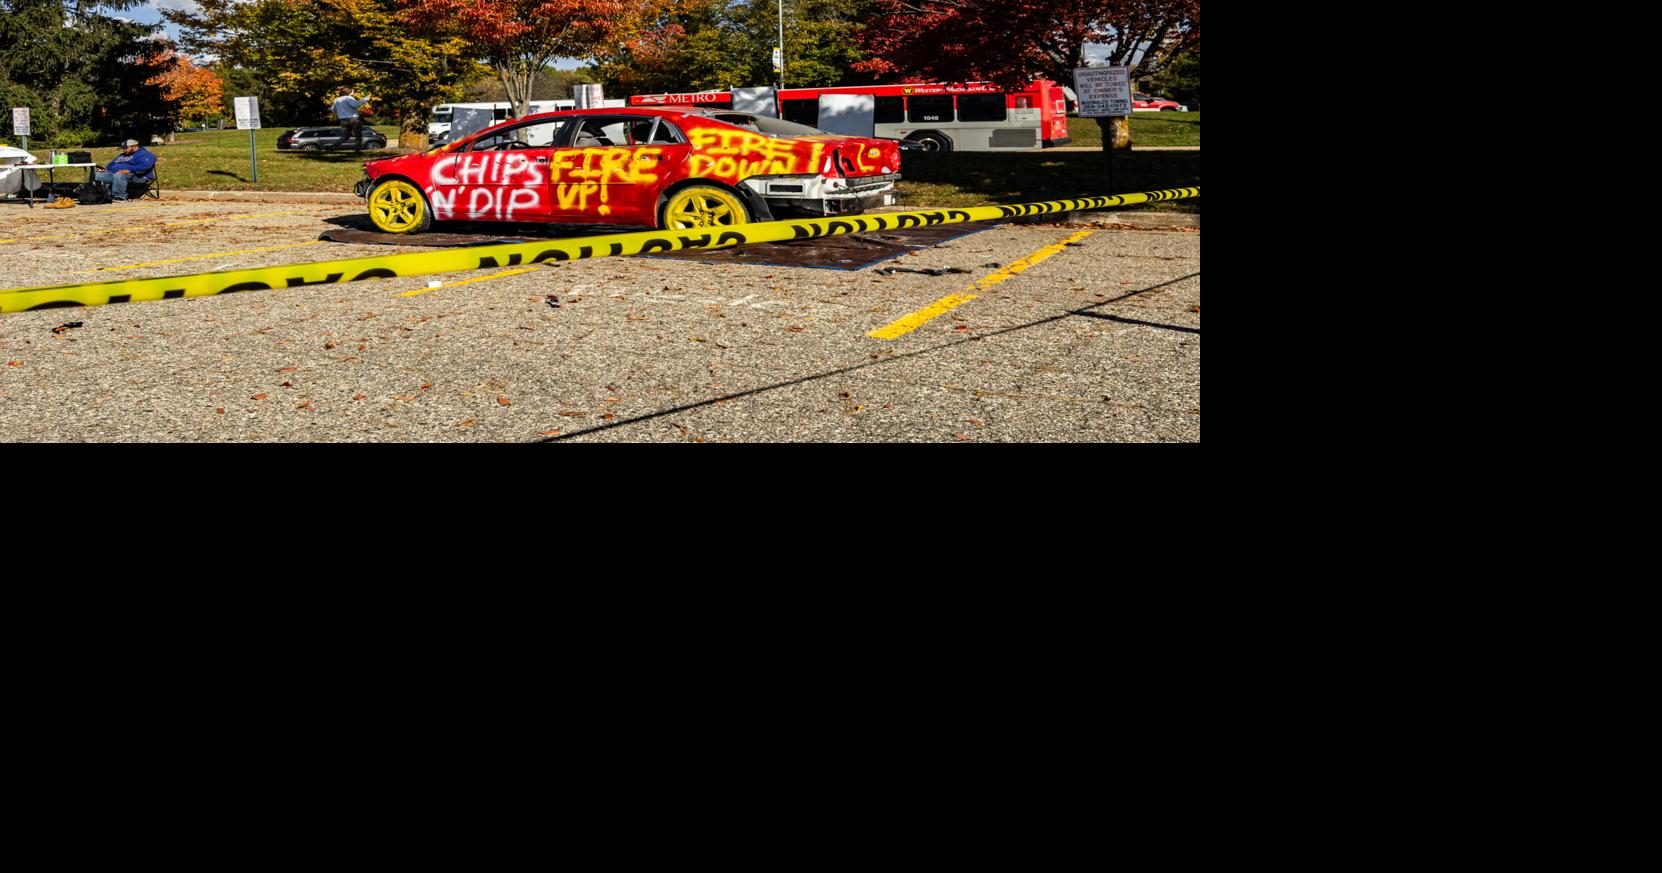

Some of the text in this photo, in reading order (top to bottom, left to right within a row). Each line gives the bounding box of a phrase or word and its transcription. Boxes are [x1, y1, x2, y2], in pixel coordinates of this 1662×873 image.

[669, 93, 717, 104] METRO
[688, 127, 798, 159] FIRE
[431, 153, 544, 187] CHIPS
[550, 146, 662, 184] FIRE
[688, 154, 797, 181] DOWN
[468, 187, 540, 219] DIP
